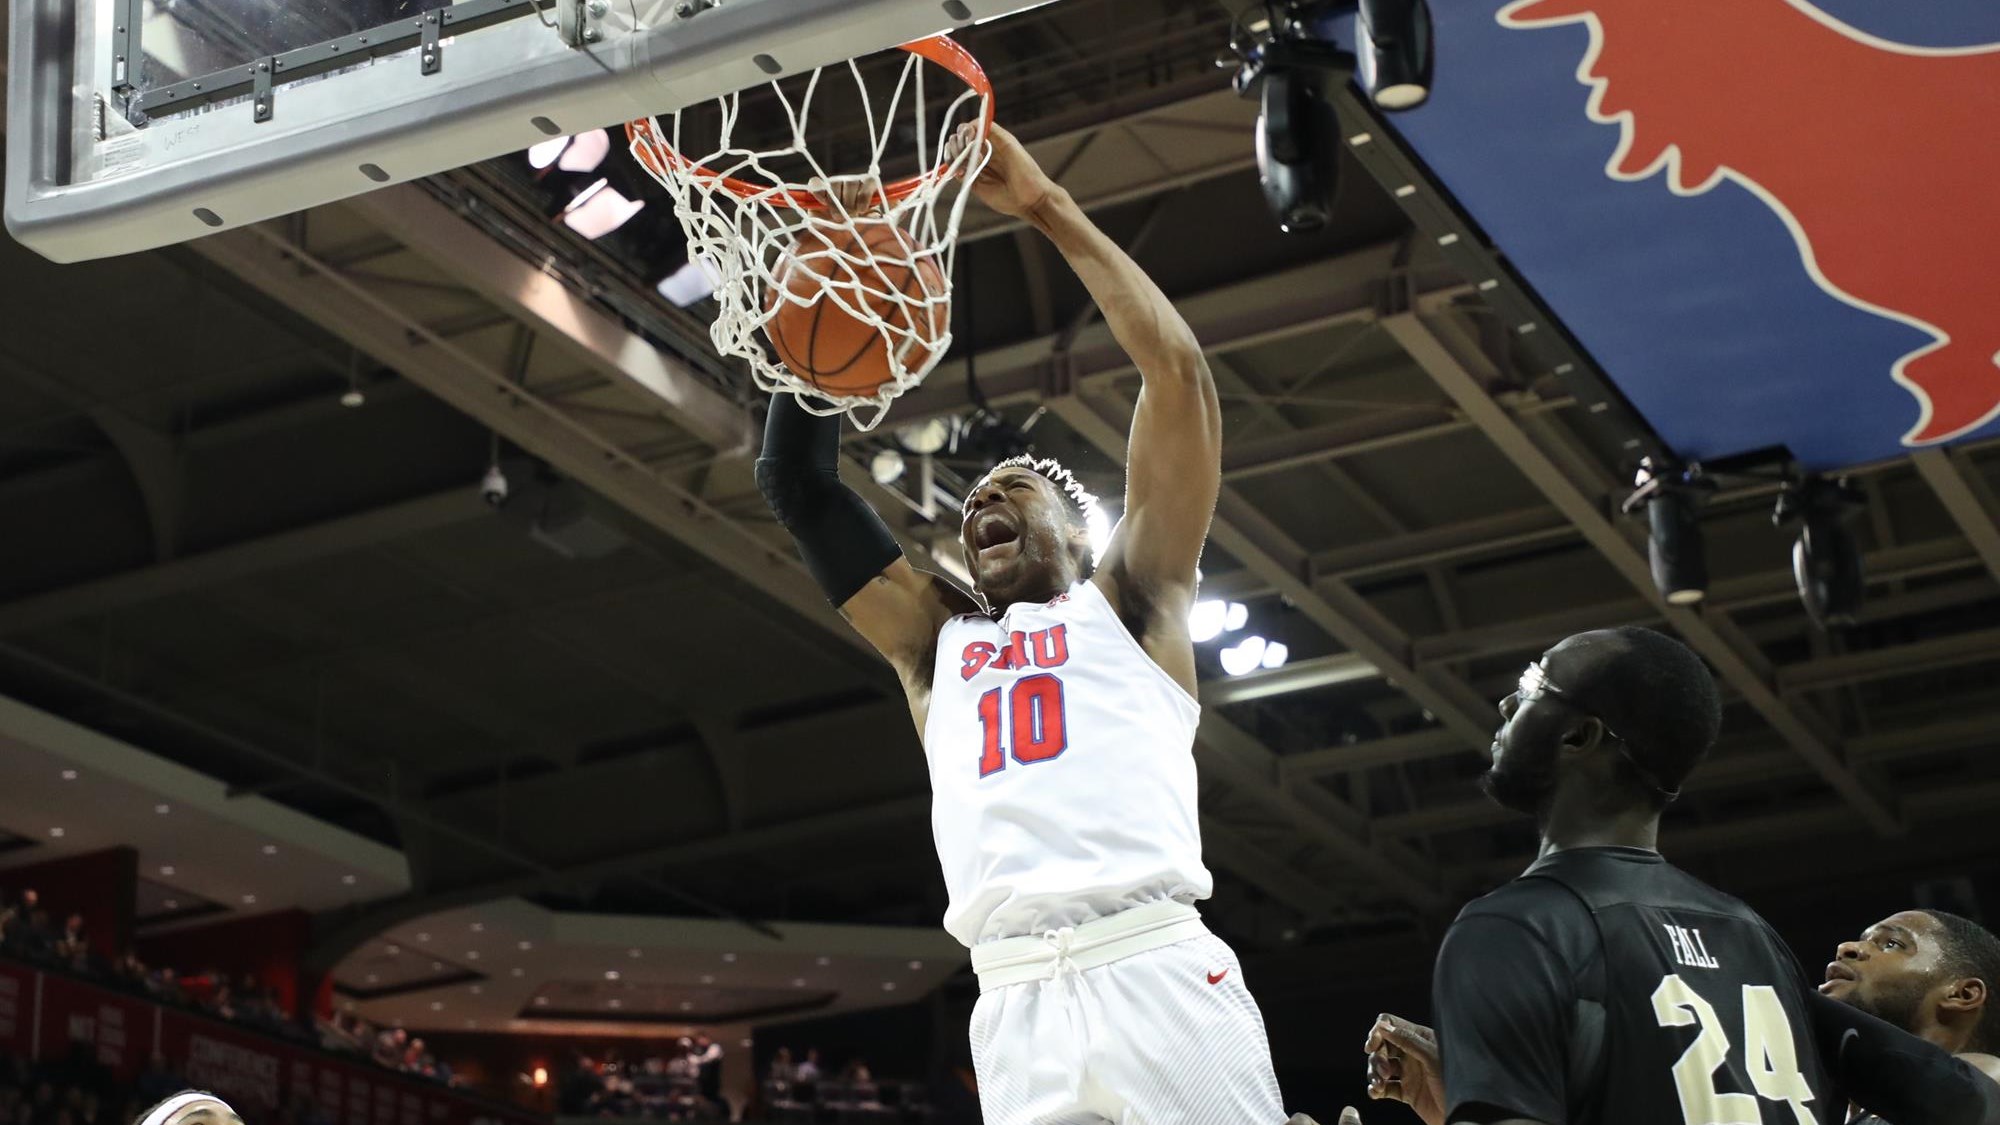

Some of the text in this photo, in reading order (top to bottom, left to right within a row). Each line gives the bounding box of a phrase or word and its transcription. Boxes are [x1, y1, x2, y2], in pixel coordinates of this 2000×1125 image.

[960, 622, 1070, 682] SMU
[977, 672, 1069, 780] 10
[1662, 923, 1720, 969] FALL
[189, 1034, 279, 1076] CONFERENCE
[1650, 973, 1819, 1125] 24
